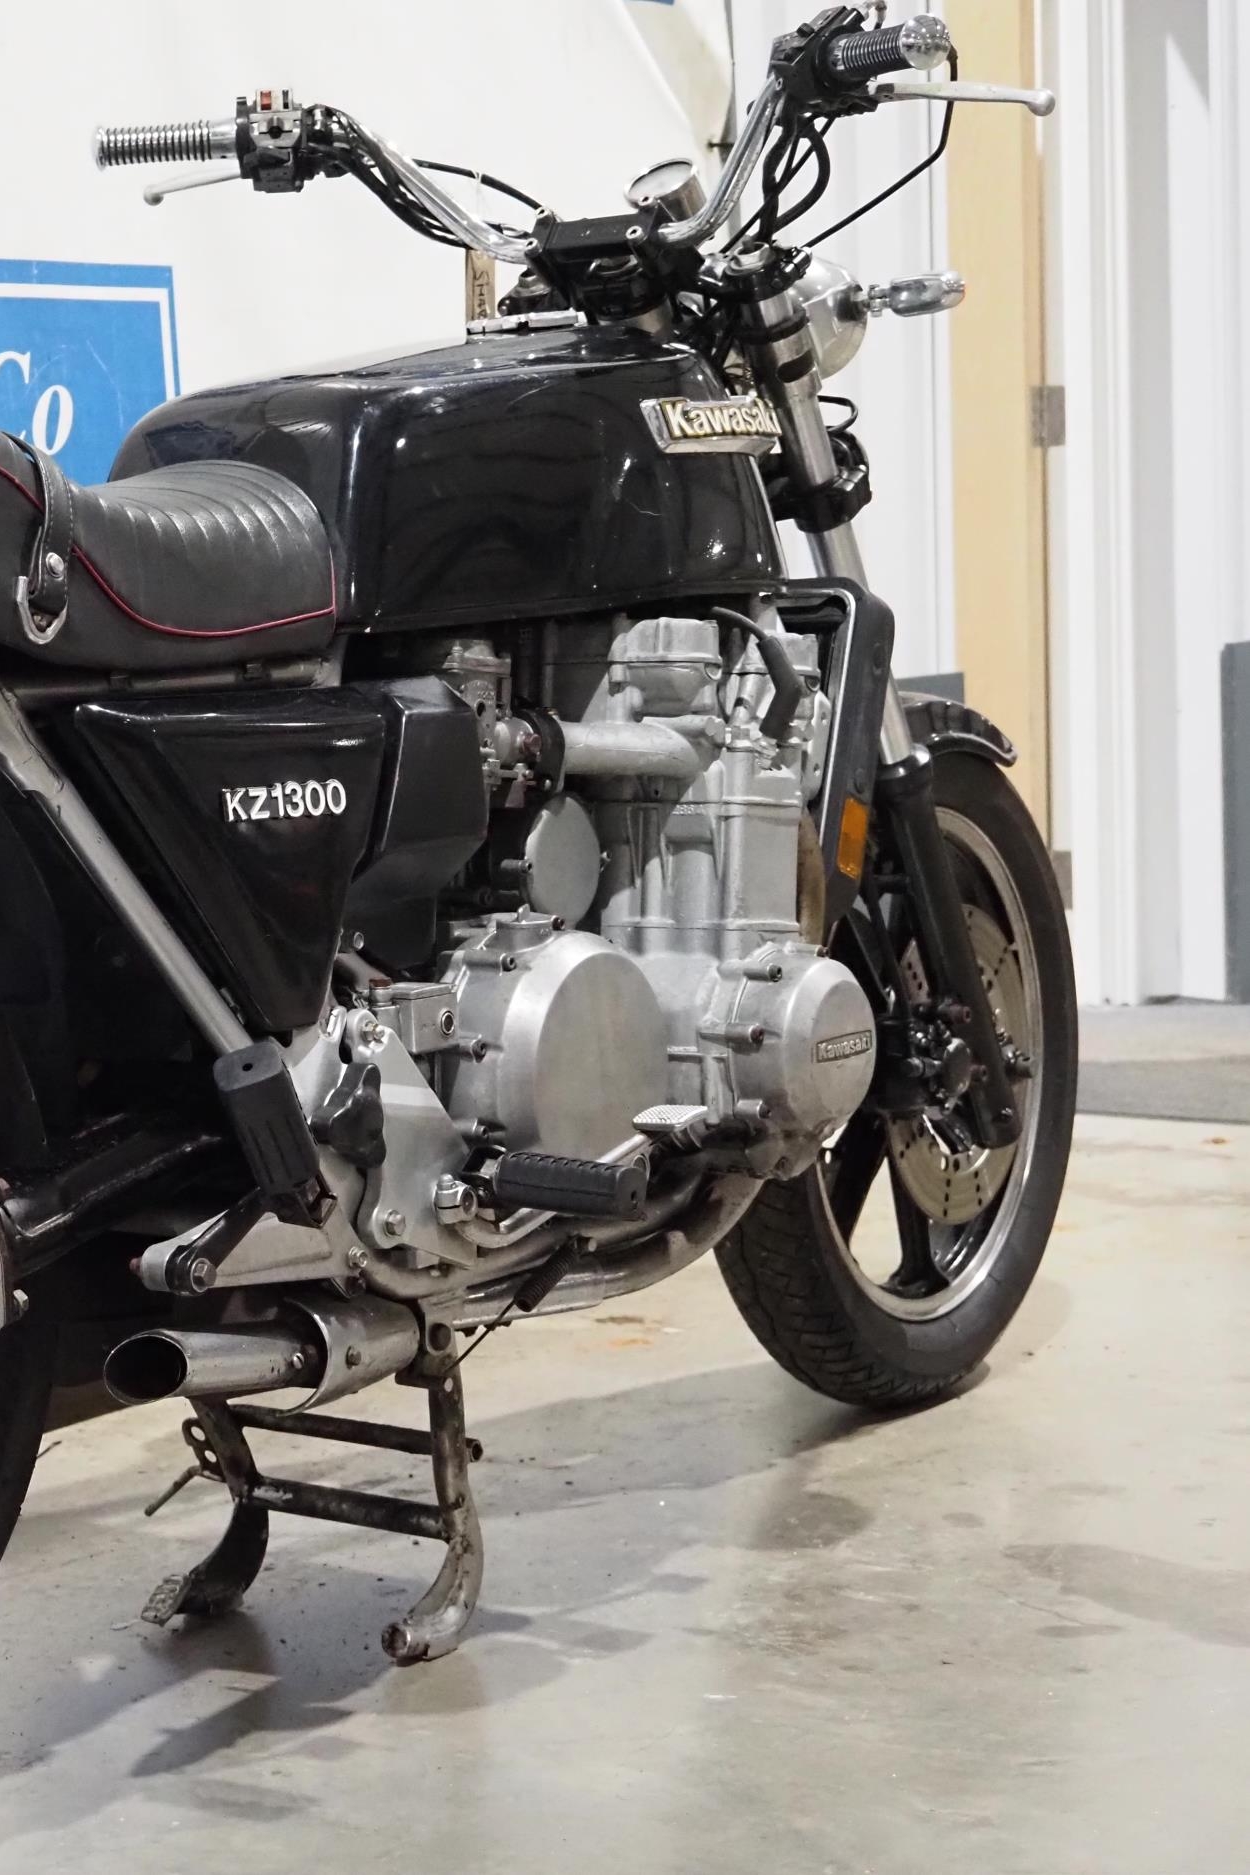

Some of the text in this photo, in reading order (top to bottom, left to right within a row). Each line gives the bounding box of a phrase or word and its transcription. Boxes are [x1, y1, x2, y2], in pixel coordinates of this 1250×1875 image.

[661, 399, 782, 437] Kawasaki
[222, 779, 347, 822] KZ1300
[817, 1032, 871, 1061] Kawasaki
